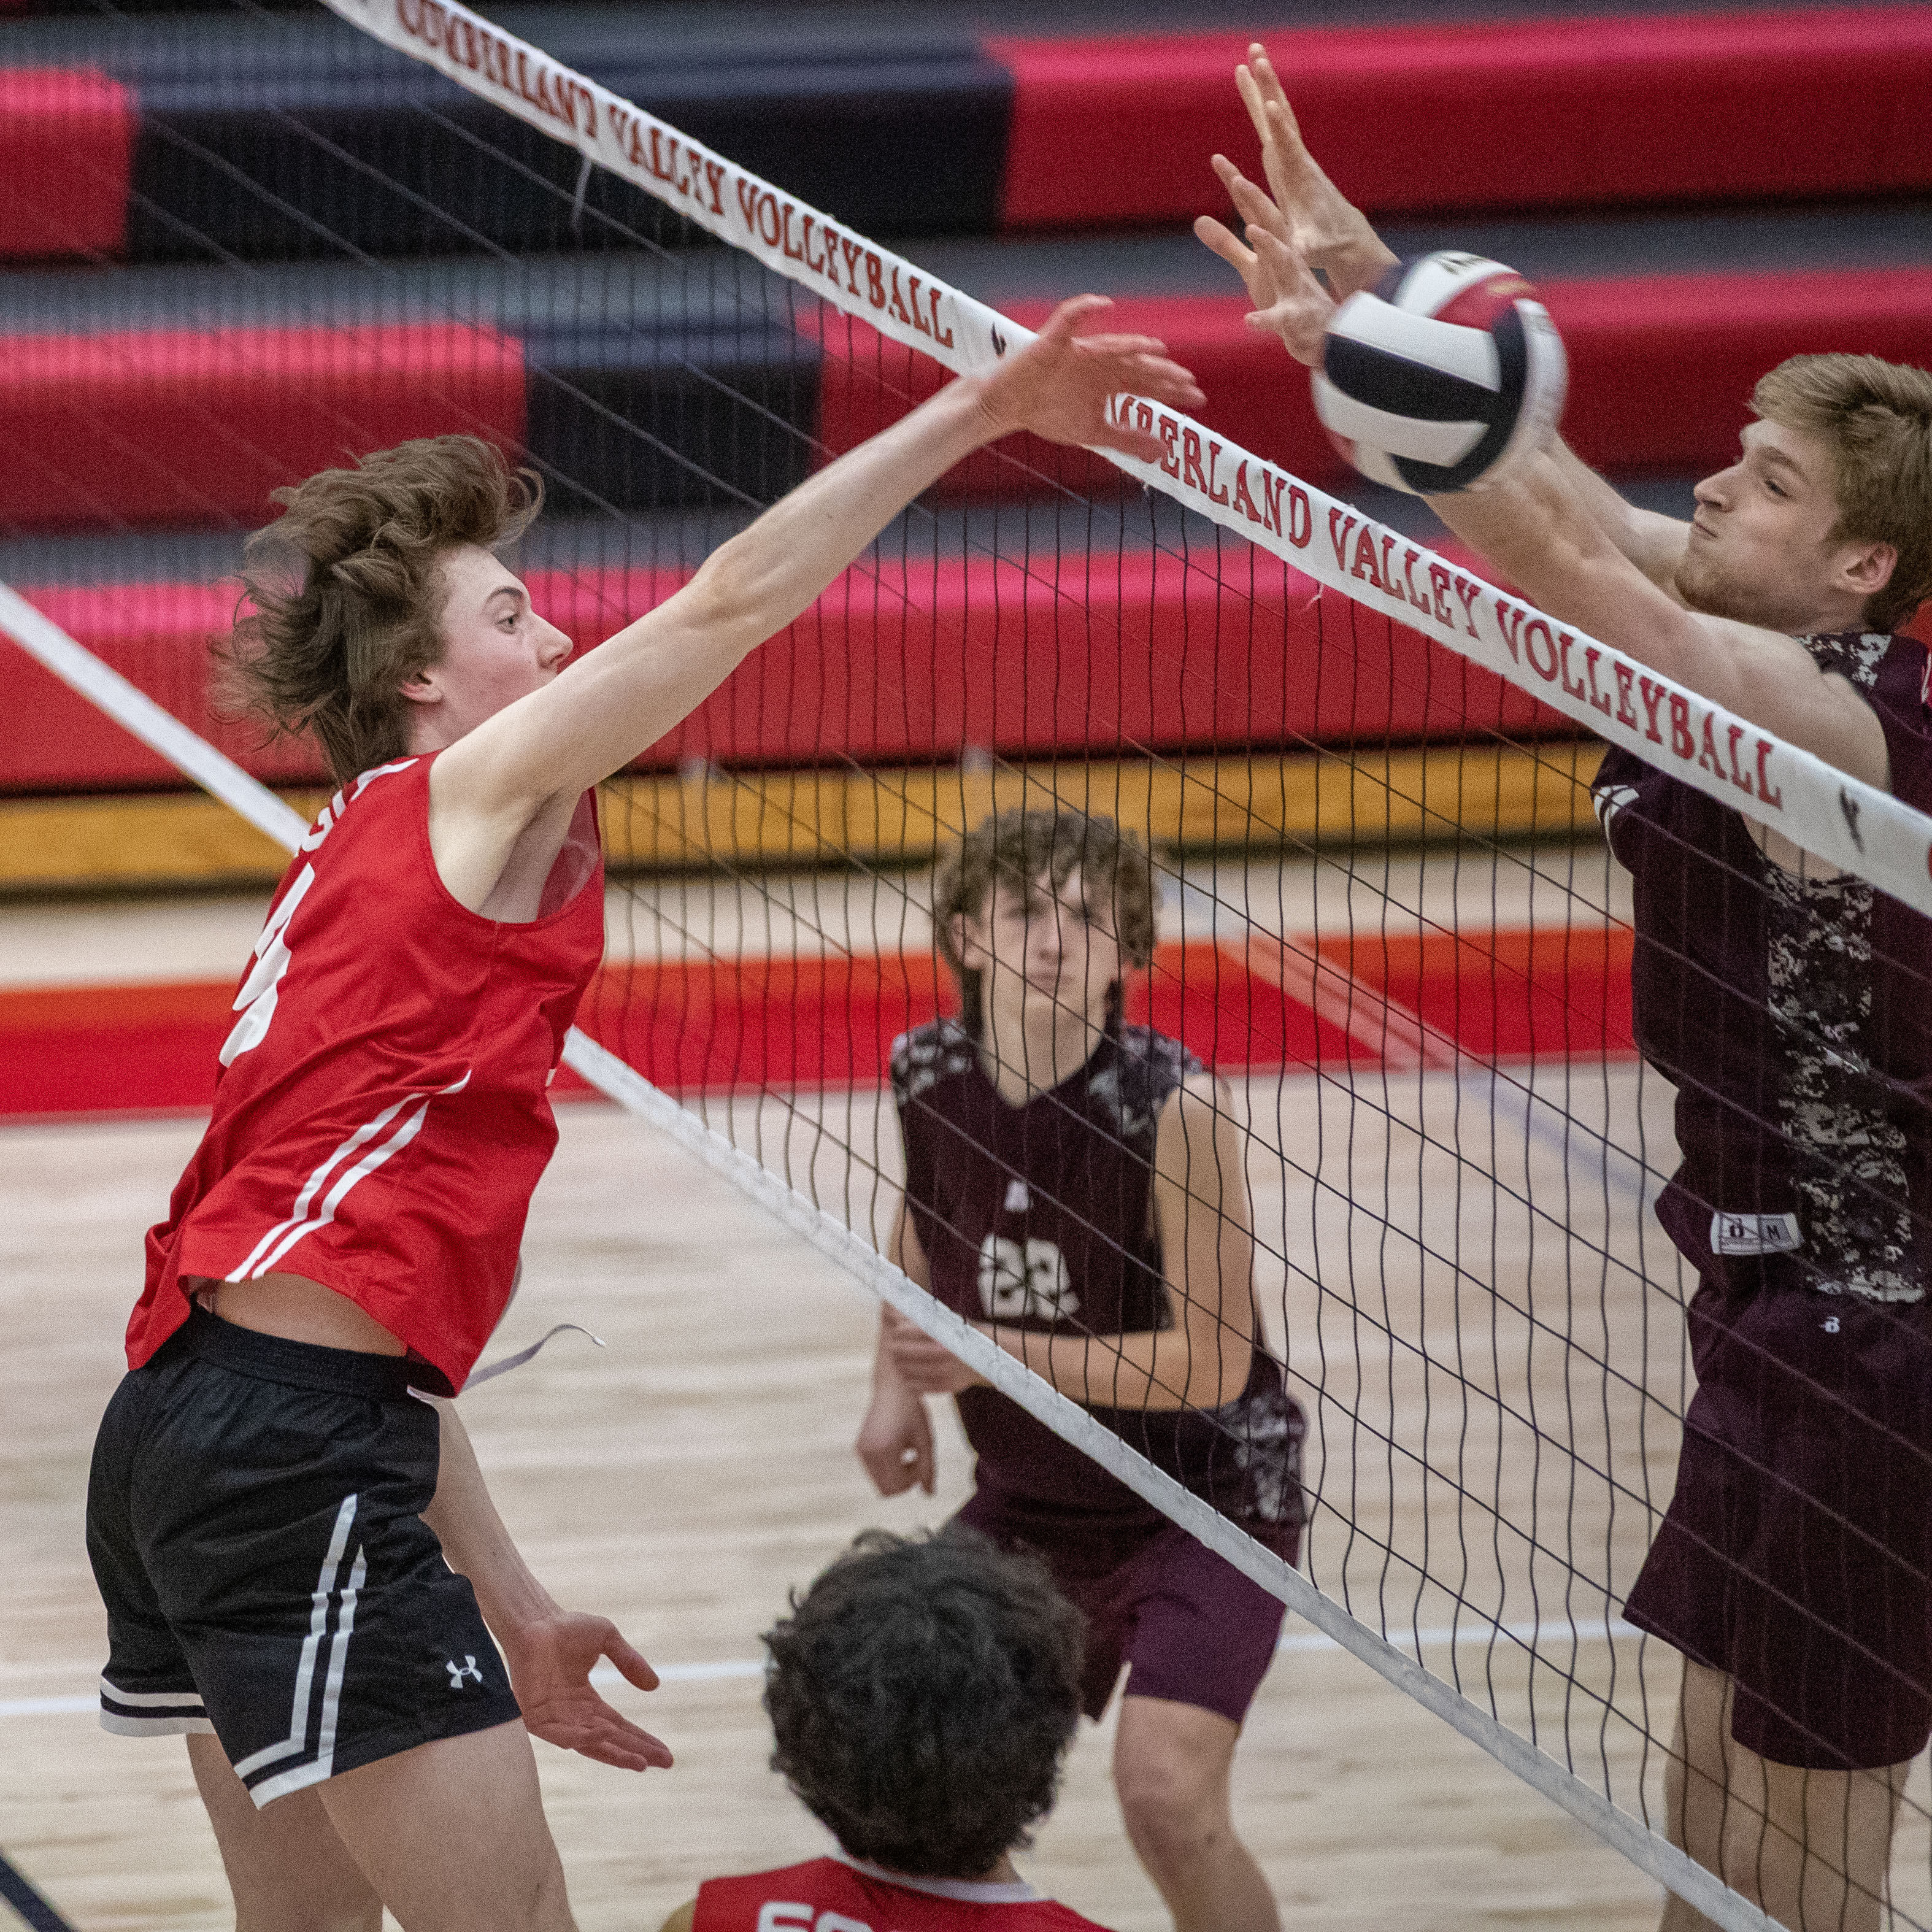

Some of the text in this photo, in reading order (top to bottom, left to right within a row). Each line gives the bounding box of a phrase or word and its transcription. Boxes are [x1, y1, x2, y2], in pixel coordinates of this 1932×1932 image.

[608, 103, 726, 217] VALLEY
[737, 176, 955, 349] VOLLEYBALL
[1106, 394, 1783, 812] ERLAND VALLEY VOLLEYBALL
